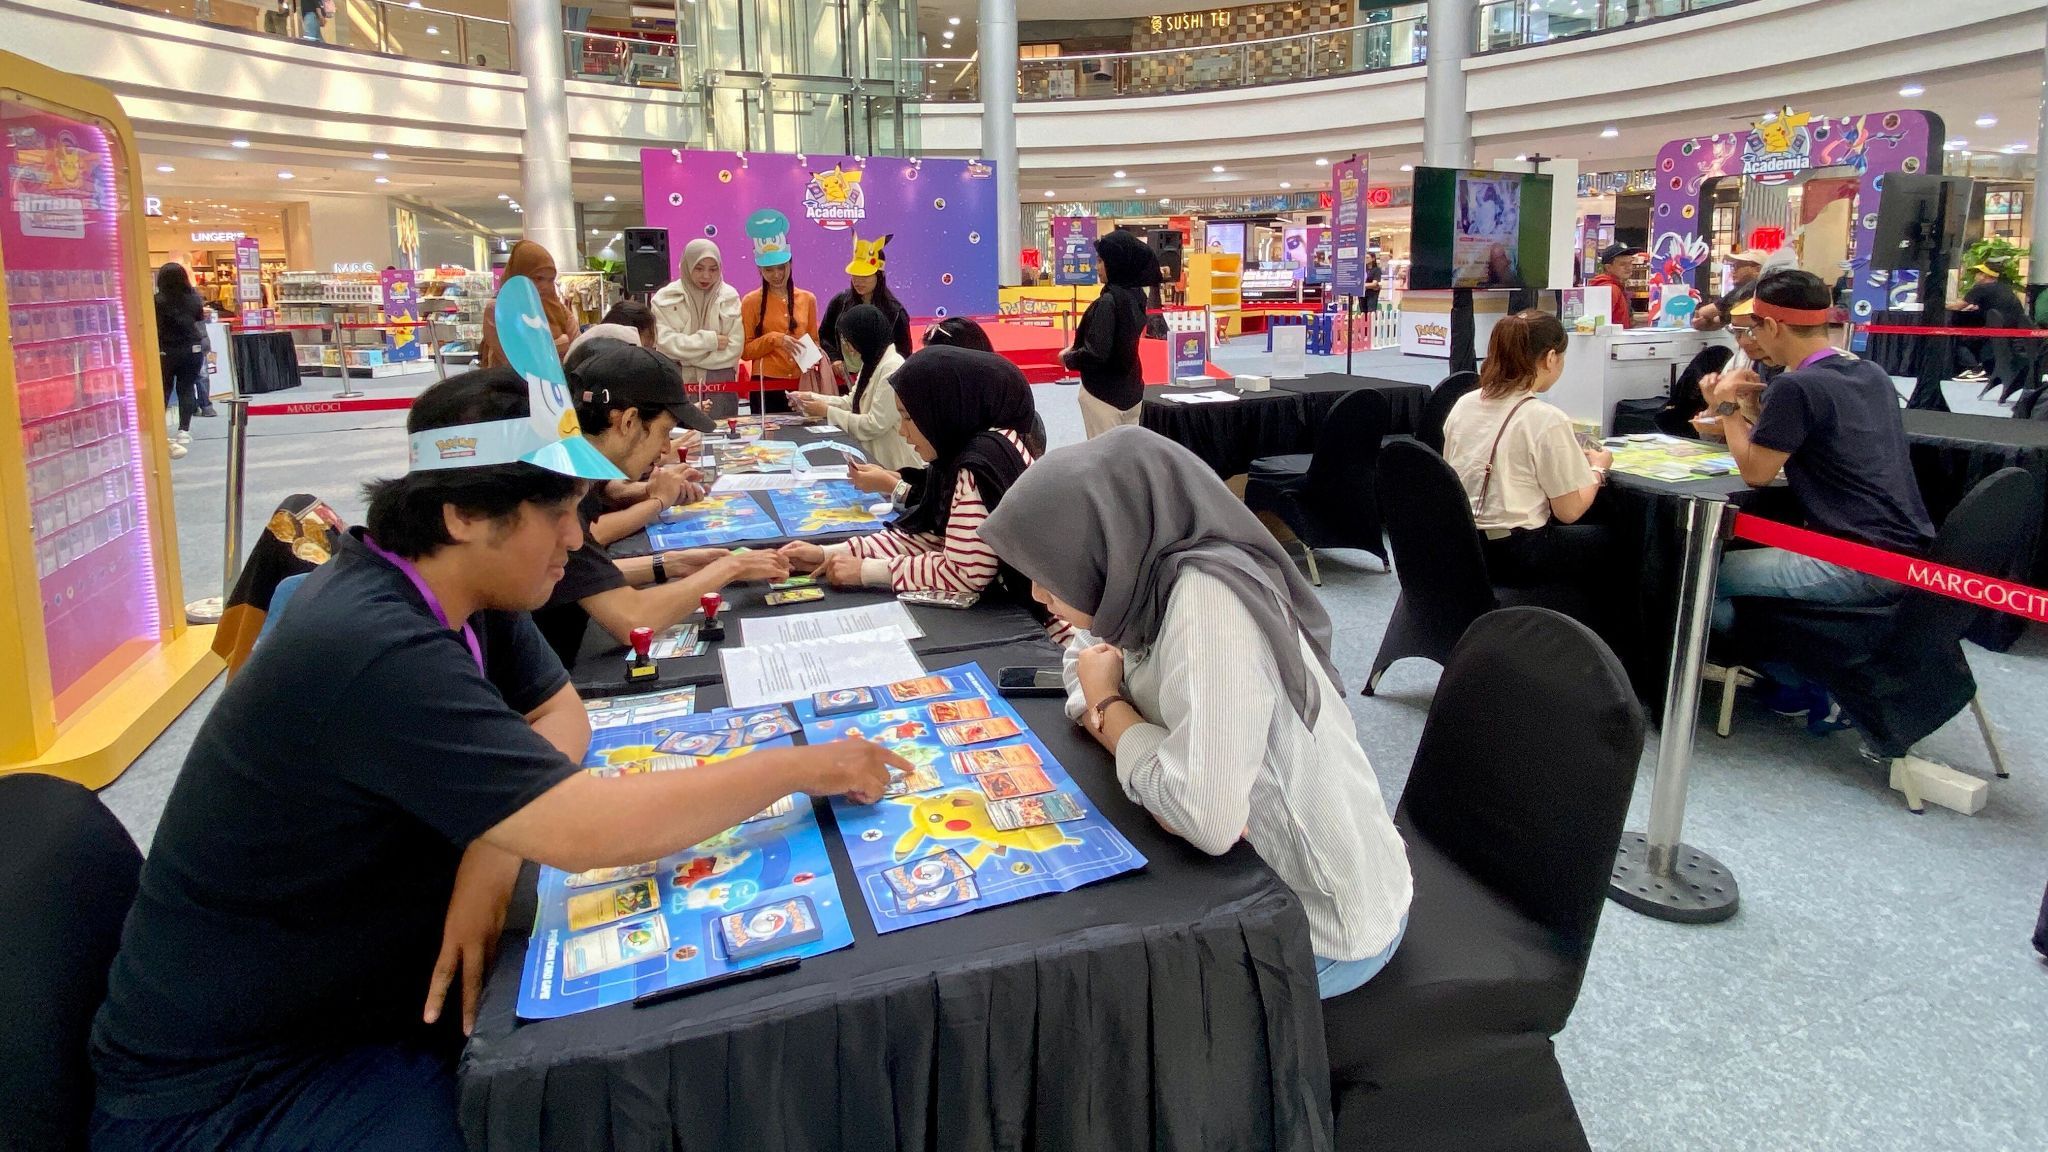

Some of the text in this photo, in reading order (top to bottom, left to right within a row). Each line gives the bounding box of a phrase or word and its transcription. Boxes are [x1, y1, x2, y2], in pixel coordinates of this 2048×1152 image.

[1166, 14, 1203, 31] SUSHI
[1210, 11, 1231, 27] TEI
[1743, 155, 1810, 174] Academia
[806, 205, 866, 218] Academia
[1907, 562, 2048, 617] MARGOCIT
